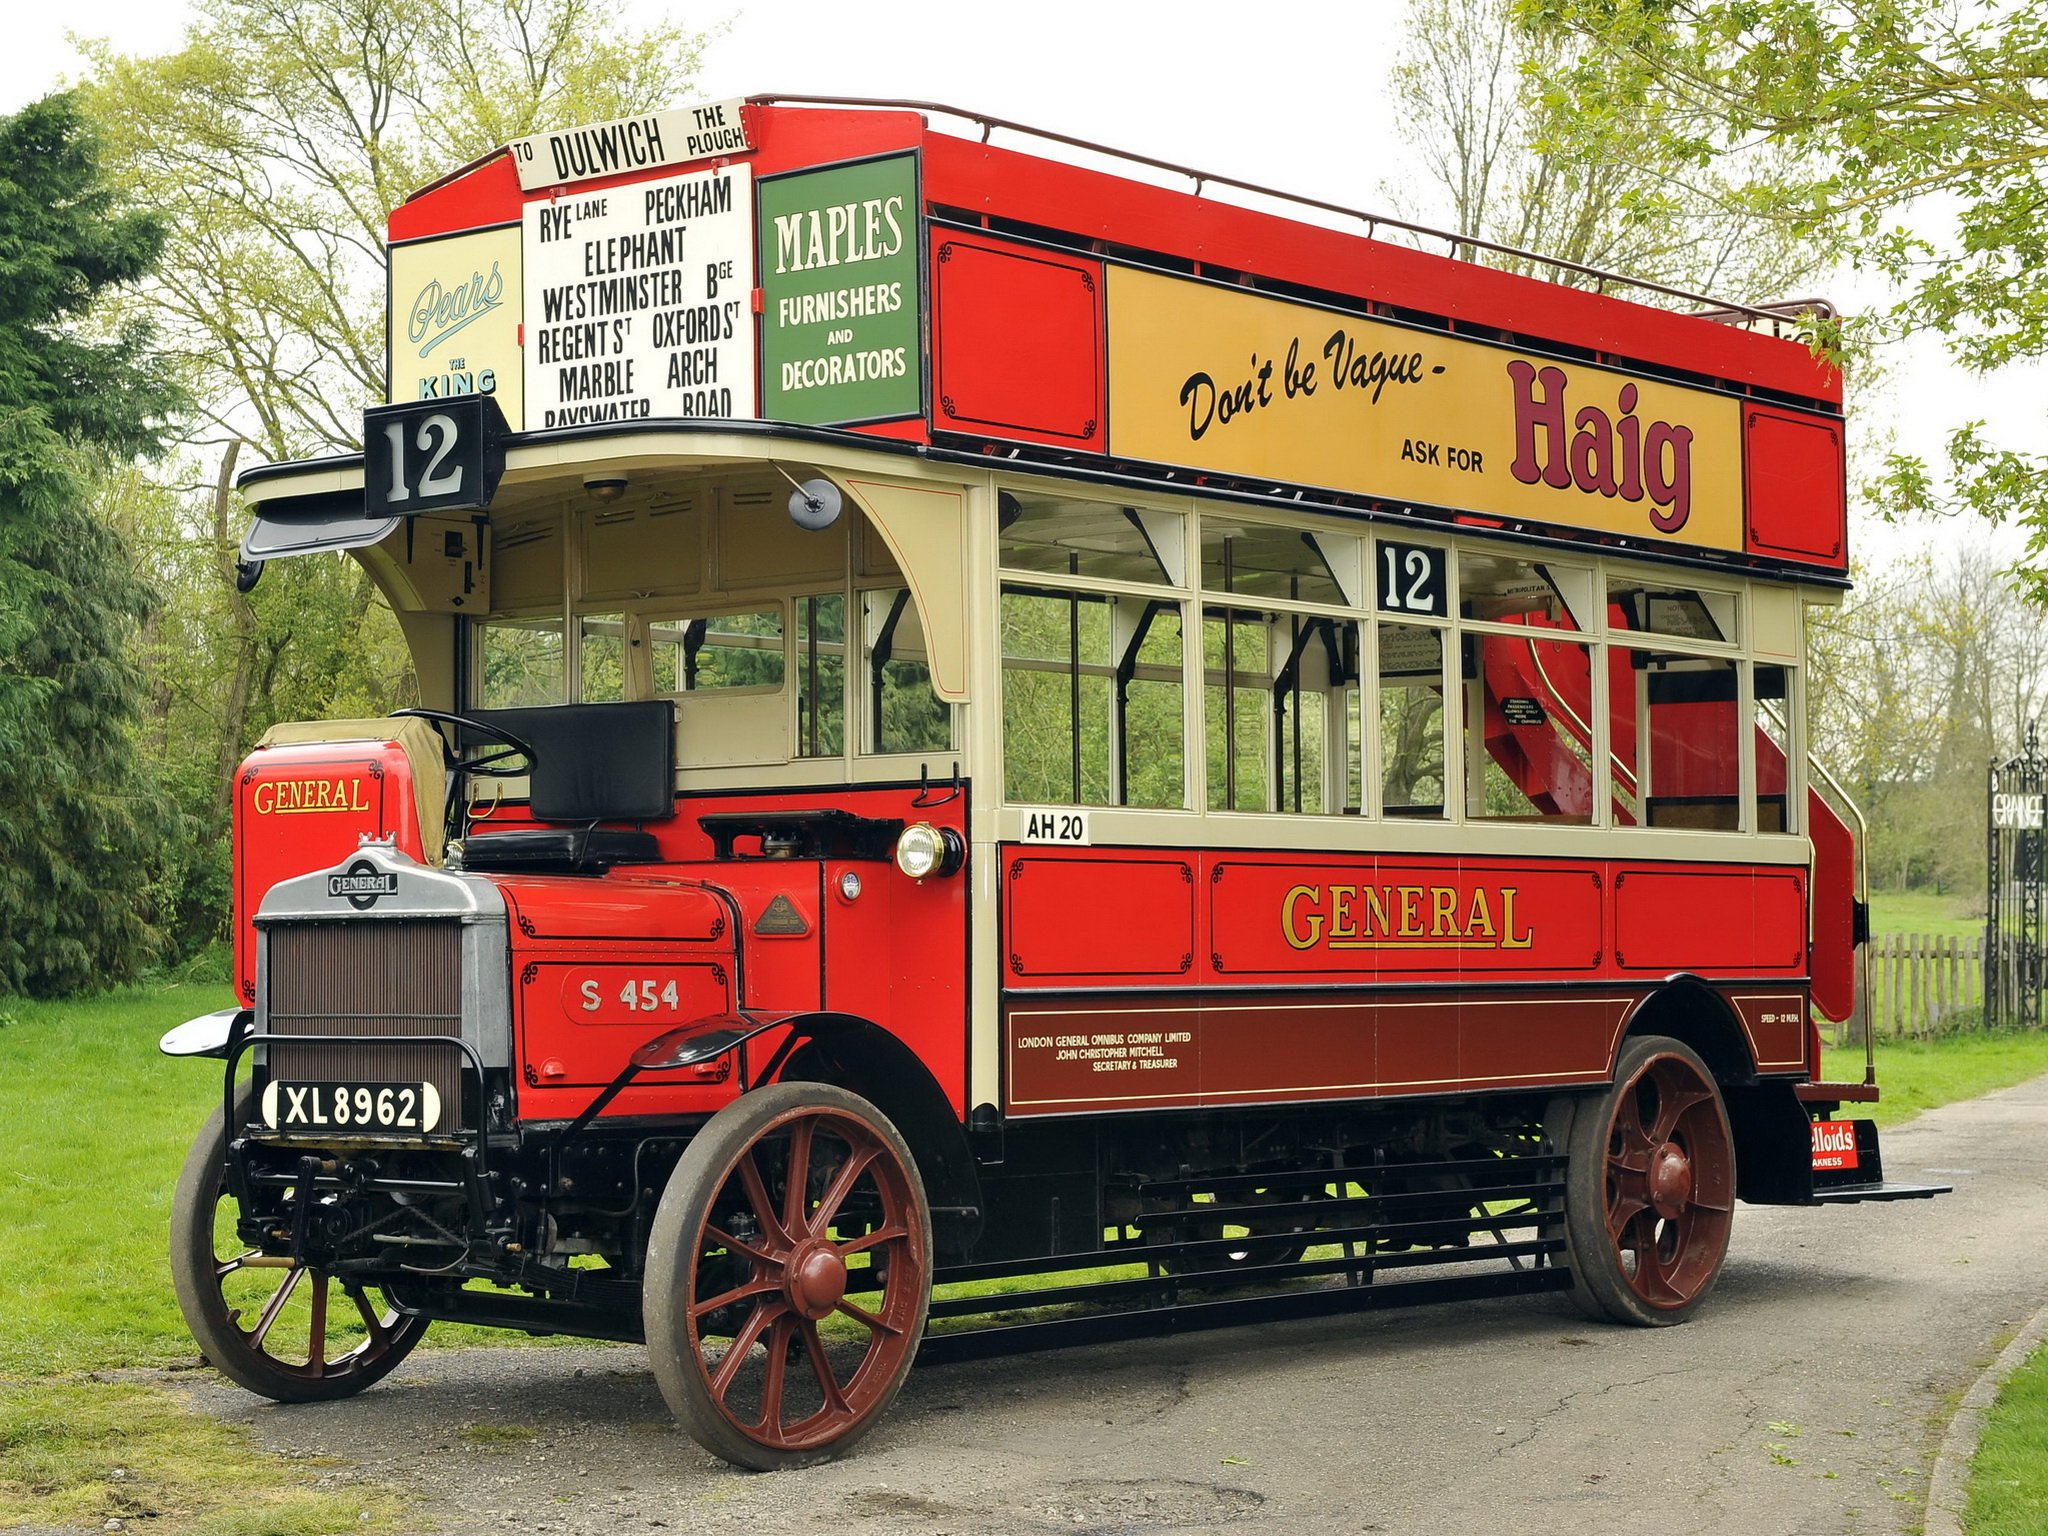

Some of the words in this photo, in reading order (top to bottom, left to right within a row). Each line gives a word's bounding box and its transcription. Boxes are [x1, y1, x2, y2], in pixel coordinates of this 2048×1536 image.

[692, 105, 726, 130] THE
[513, 141, 533, 162] TO
[550, 118, 665, 180] DULWICH
[687, 127, 744, 156] PLOUGH
[540, 205, 572, 243] RYE
[576, 198, 607, 221] LANE
[645, 175, 732, 225] PECKHAM
[585, 226, 686, 277] ELEPHANT
[773, 195, 903, 274] MAPLES
[408, 261, 503, 356] Pears
[543, 269, 682, 323] WESTMINSTER
[779, 282, 902, 328] FURNISHERS
[539, 321, 608, 364] REGENT
[653, 304, 720, 349] OXFORD
[827, 328, 853, 345] AND
[419, 369, 496, 400] KING
[449, 358, 466, 370] THE
[559, 359, 634, 402] MARBLE
[667, 347, 718, 389] ARCH
[782, 347, 906, 391] DECORATORS
[1180, 352, 1273, 441] Don't
[1284, 337, 1318, 399] be
[384, 414, 463, 503] 12
[1401, 439, 1440, 466] ASK
[1447, 447, 1484, 473] FOR
[1507, 360, 1694, 534] Haig
[1385, 547, 1434, 611] 12
[254, 779, 369, 815] GENERAL
[1027, 813, 1055, 839] AH
[1059, 815, 1083, 840] 20
[329, 875, 397, 895] GENERAL
[1281, 885, 1534, 950] GENERAL
[581, 980, 602, 1012] S
[620, 980, 679, 1012] 454
[1018, 1036, 1053, 1049] LONDON
[1055, 1035, 1089, 1047] GENERAL
[1091, 1034, 1125, 1046] OMNIBUS
[1127, 1033, 1162, 1044] COMPANY
[1164, 1032, 1191, 1043] LIMITED
[1056, 1049, 1078, 1061] JOHN
[1079, 1047, 1128, 1059] CHRISTOPHER
[1129, 1046, 1164, 1057] MITCHELL
[1092, 1060, 1131, 1072] SECRETARY
[1139, 1059, 1178, 1070] TREASURER
